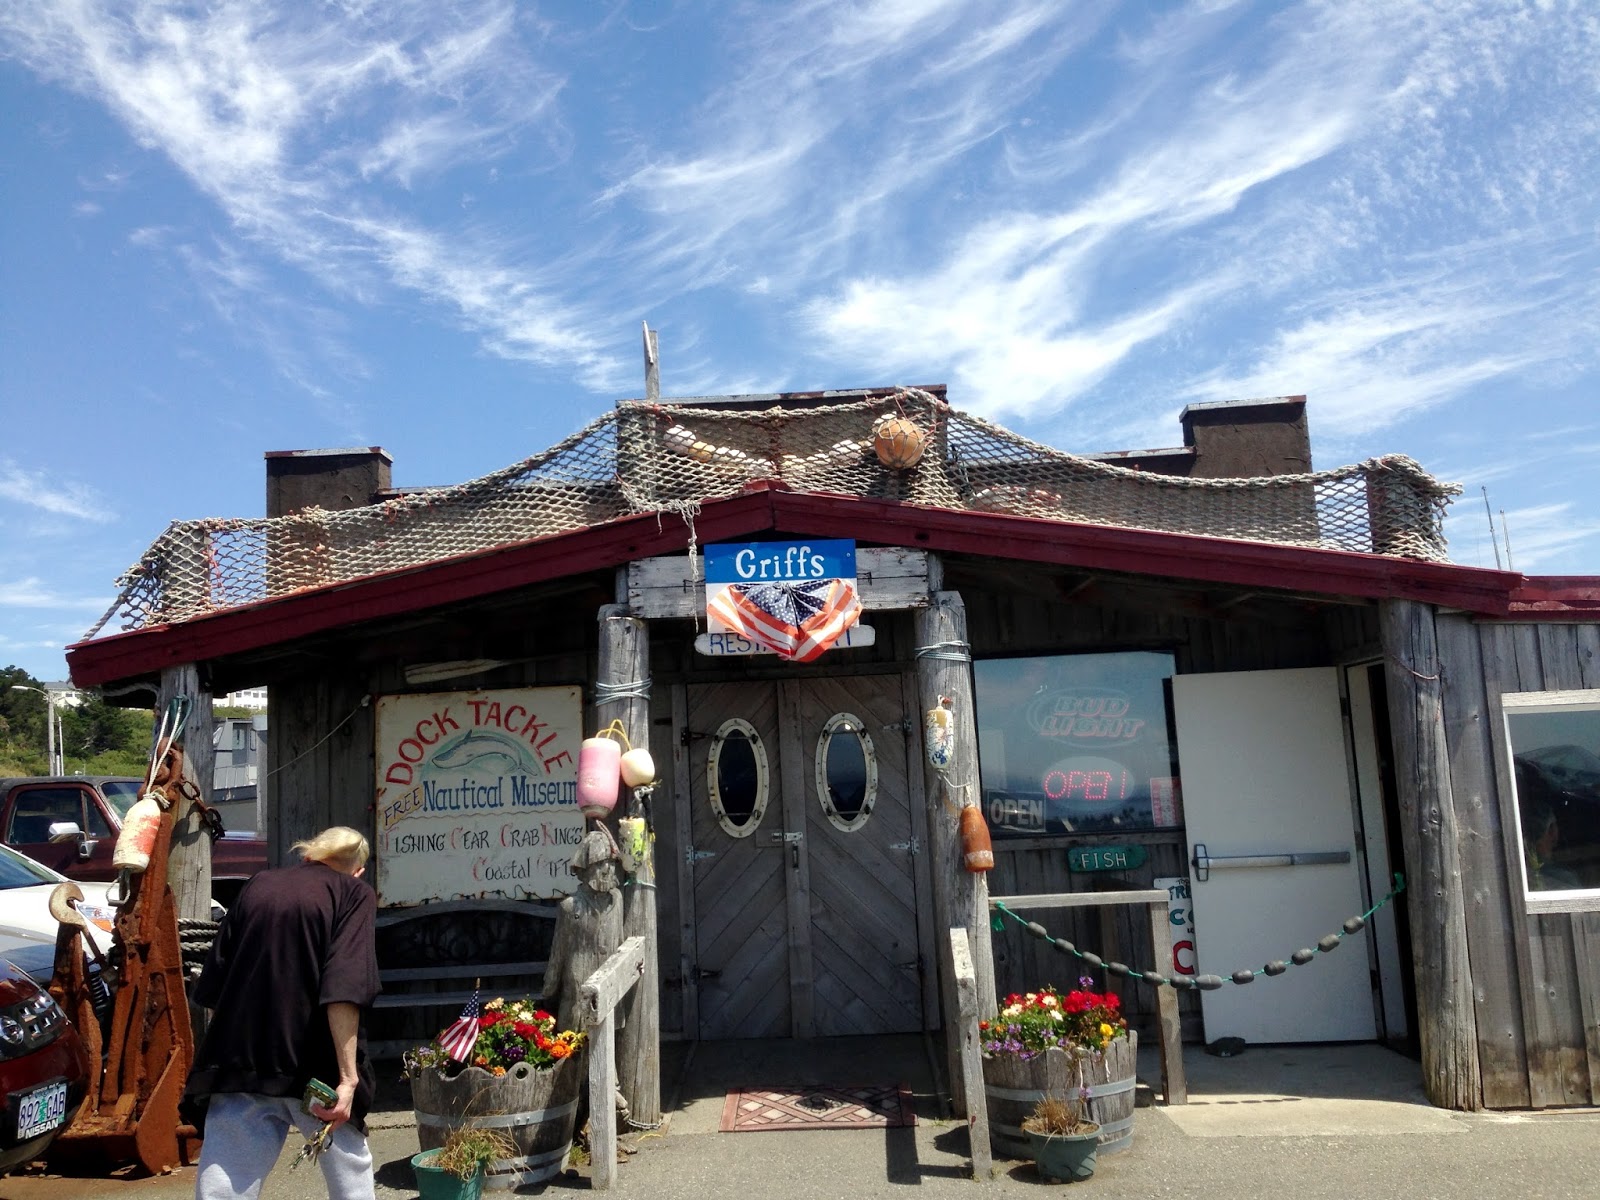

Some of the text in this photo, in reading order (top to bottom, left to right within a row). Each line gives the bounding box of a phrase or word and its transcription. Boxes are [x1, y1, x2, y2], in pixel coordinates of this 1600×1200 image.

[736, 546, 825, 578] Griffs
[1054, 696, 1130, 717] BUD
[1040, 715, 1145, 738] LIGHT
[386, 699, 573, 786] DOCK TACKLE
[384, 787, 420, 826] FREE
[422, 776, 503, 812] Nautical
[990, 798, 1043, 825] OPEN
[501, 822, 540, 848] CRAB
[473, 856, 530, 881] Coastal
[1081, 852, 1127, 868] FISH
[25, 1118, 59, 1139] NISSAN
